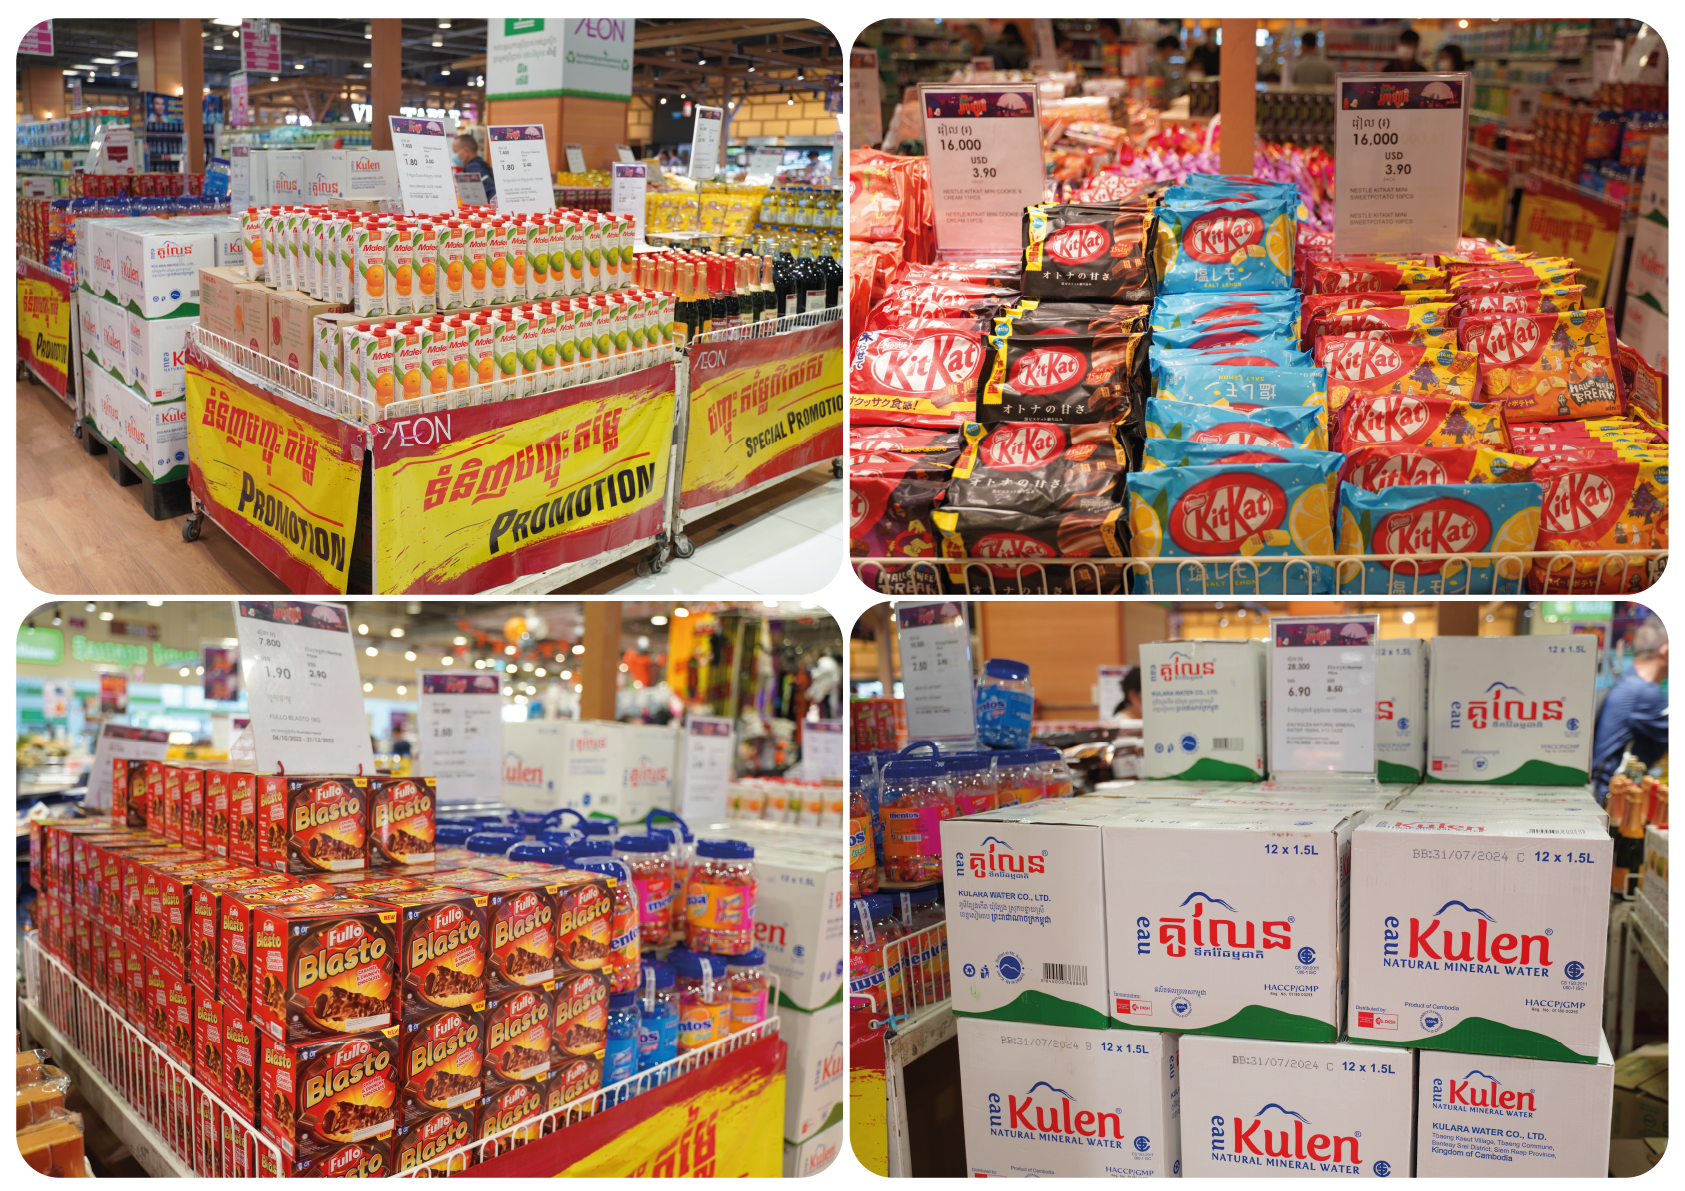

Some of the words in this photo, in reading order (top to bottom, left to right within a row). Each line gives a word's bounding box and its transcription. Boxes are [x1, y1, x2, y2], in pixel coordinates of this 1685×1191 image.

[940, 139, 982, 152] 16,000
[1353, 132, 1399, 146] 16,000
[971, 156, 988, 165] USD
[1385, 151, 1404, 160] USD
[972, 167, 997, 178] 3.90
[1385, 164, 1412, 175] 3.90
[1060, 228, 1101, 259] KitKat
[1200, 216, 1252, 254] KitKat
[1194, 267, 1252, 282] 塩レモン
[1476, 317, 1536, 364] KitKat
[883, 335, 977, 391] KitKat
[1025, 352, 1076, 387] KitKat
[1330, 341, 1397, 381] KitKat
[162, 410, 187, 423] Kule
[745, 420, 787, 458] SPECIAL
[1000, 427, 1053, 465] KitKat
[489, 462, 655, 555] PROMOTION
[238, 470, 347, 572] PROMOTION
[265, 666, 291, 679] 1.90
[309, 670, 327, 679] 2.90
[1287, 663, 1310, 671] 28,300
[1288, 686, 1311, 697] 6.90
[1327, 685, 1343, 693] 8.50
[1450, 701, 1462, 729] eau
[260, 791, 283, 808] Blasto
[317, 785, 342, 801] Fullo
[394, 783, 416, 799] Fullo
[295, 796, 361, 832] Blasto
[375, 795, 432, 829] Blasto
[1264, 844, 1279, 854] 12
[1282, 847, 1290, 855] x
[1293, 845, 1318, 855] 1.5L
[1412, 849, 1509, 862] BB:31/07/2024
[1516, 852, 1525, 863] C
[1534, 851, 1550, 862] 12
[1553, 854, 1562, 863] x
[1567, 852, 1595, 864] 1.5L
[955, 851, 965, 877] eau
[515, 895, 537, 914] Fullo
[579, 889, 598, 905] Fullo
[958, 890, 989, 898] KULARA
[989, 891, 1016, 900] WATER
[1034, 894, 1051, 902] LTD.
[436, 908, 463, 931] Fullo
[560, 897, 611, 937] Blasto
[329, 926, 363, 946] Fullo
[494, 905, 552, 950] Blasto
[1159, 902, 1291, 958] គូលែន
[411, 919, 481, 969] Blasto
[1409, 917, 1553, 967] Kulen
[298, 937, 388, 990] Blasto
[1383, 957, 1440, 971] NATURAL
[1444, 962, 1500, 975] MINERAL
[1264, 983, 1319, 993] HACCP/GMP
[555, 984, 607, 1028] Blasto
[1525, 998, 1586, 1009] HACCP/GMP
[434, 1016, 461, 1039] Fullo
[490, 1002, 549, 1050] Blasto
[411, 1024, 479, 1077] Blasto
[1001, 1036, 1079, 1050] BB:31/07/2024
[1101, 1042, 1114, 1052] 12
[1116, 1045, 1123, 1053] x
[1126, 1043, 1149, 1054] 1.5L
[336, 1042, 369, 1066] Fullo
[1232, 1055, 1319, 1070] BB:31/07/2024
[1342, 1061, 1356, 1072] 12
[1359, 1064, 1366, 1072] x
[1370, 1063, 1396, 1074] 1.5L
[306, 1050, 390, 1109] Blasto
[1433, 1077, 1443, 1102] eau
[1008, 1094, 1125, 1140] Kulen
[1432, 1102, 1468, 1112] NATURAL
[1469, 1106, 1504, 1116] MINERAL
[1506, 1109, 1534, 1118] WATER
[1432, 1122, 1470, 1133] KULARA
[1471, 1126, 1504, 1137] WATER
[1505, 1129, 1525, 1140] CO.,
[1527, 1132, 1547, 1141] LTD.
[1431, 1146, 1464, 1157] Kingdom
[1465, 1150, 1474, 1158] of
[1475, 1151, 1513, 1162] Cambodia
[1521, 1142, 1555, 1152] Commune,
